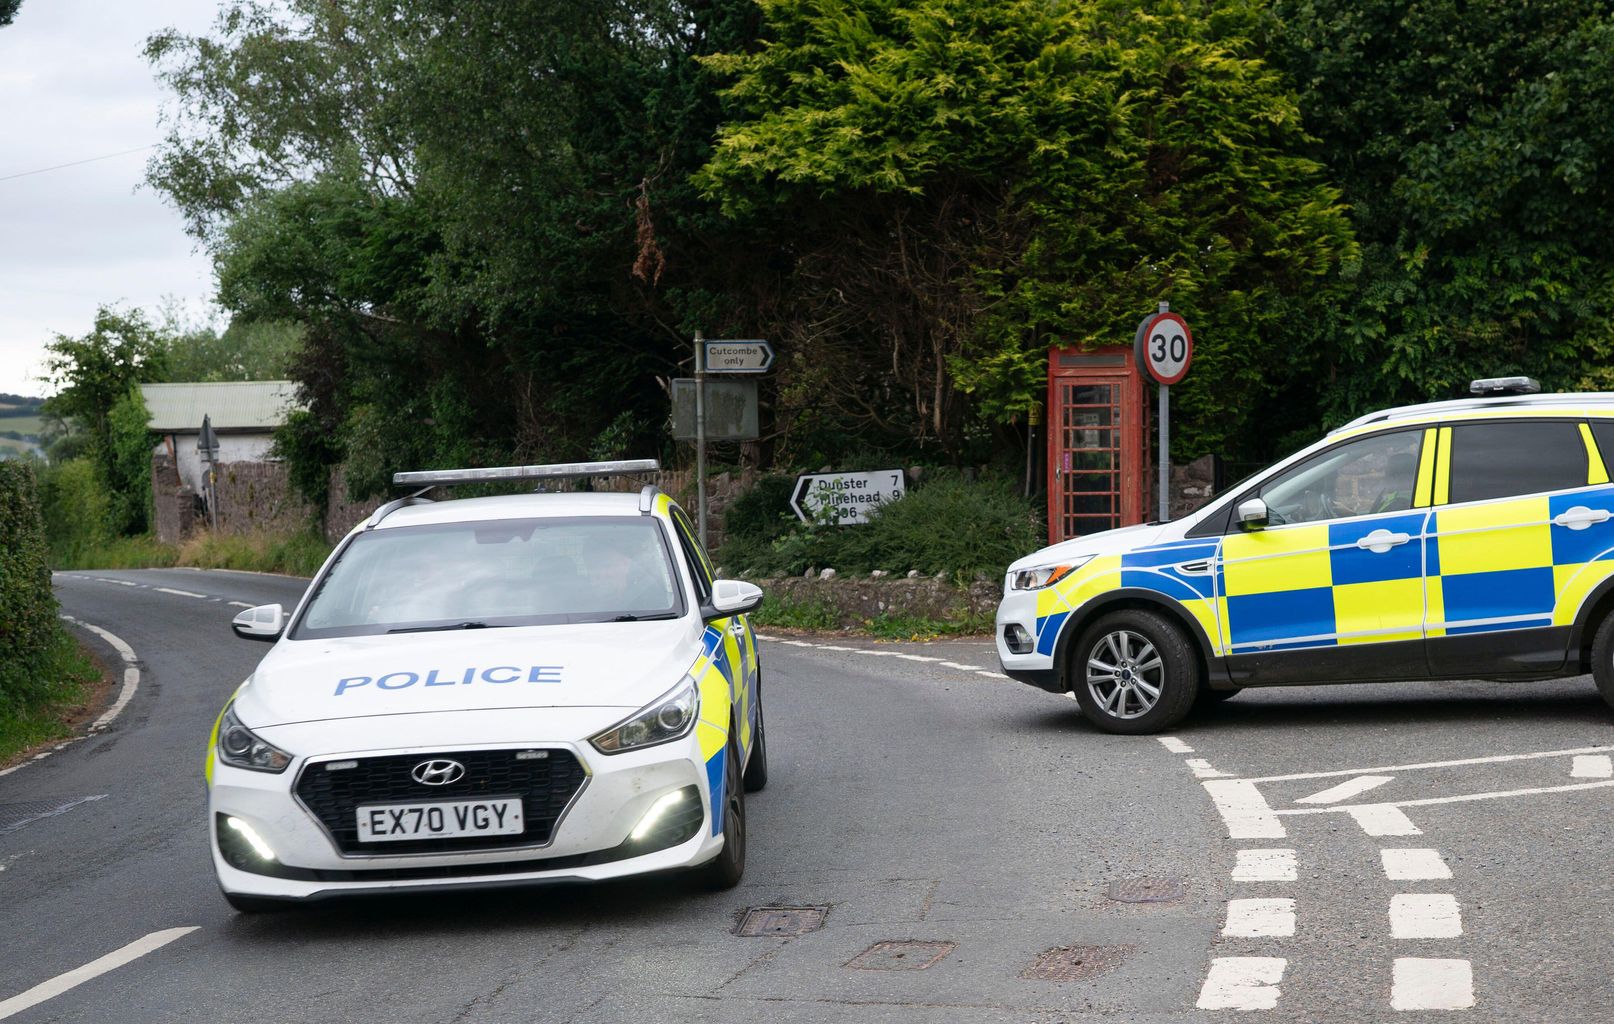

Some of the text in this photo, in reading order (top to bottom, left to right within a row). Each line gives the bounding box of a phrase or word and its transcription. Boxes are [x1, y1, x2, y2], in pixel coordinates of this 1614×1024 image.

[710, 347, 758, 355] Cutcombe
[1152, 334, 1185, 363] 30
[724, 357, 744, 366] only
[819, 475, 898, 491] Dunster 7
[892, 490, 900, 501] 9
[334, 666, 564, 696] POLICE
[370, 803, 508, 835] EX70 VGY
